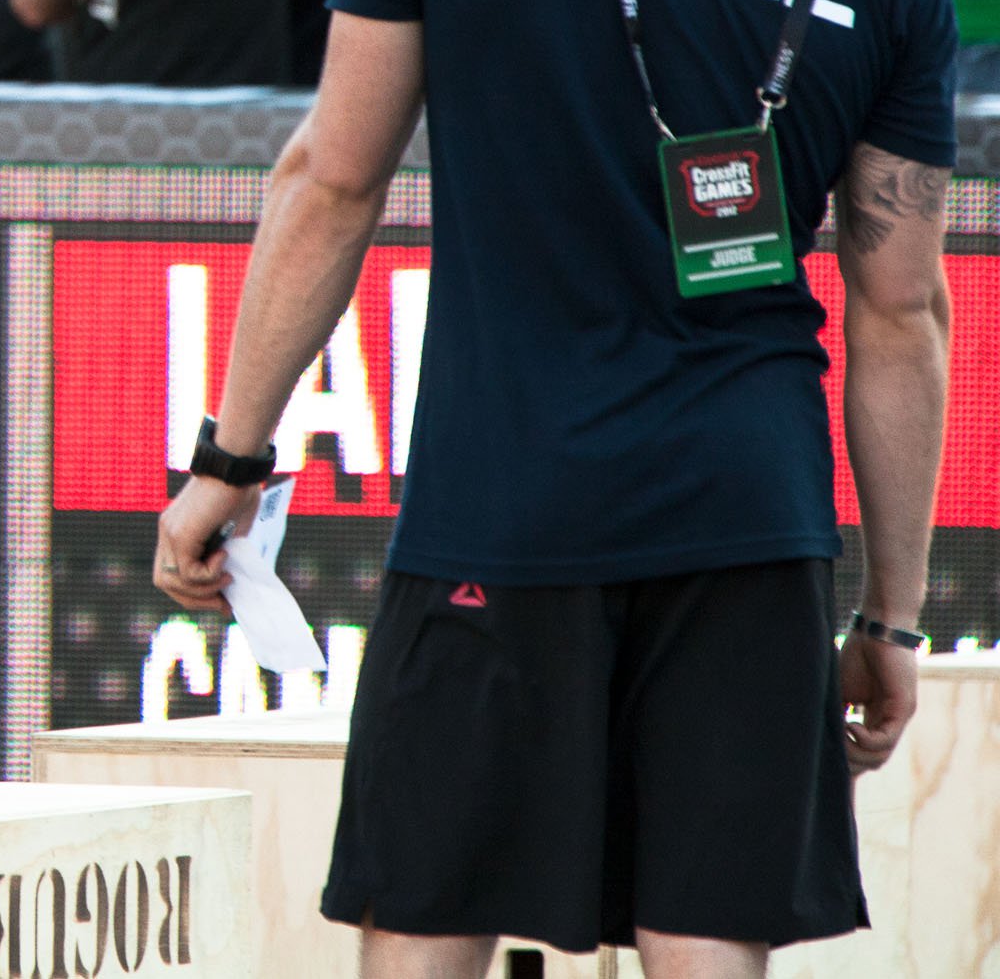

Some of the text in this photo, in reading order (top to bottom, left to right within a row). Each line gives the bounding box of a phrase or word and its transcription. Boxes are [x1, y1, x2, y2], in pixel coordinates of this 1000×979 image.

[691, 160, 750, 186] CrossFit
[693, 181, 753, 203] GAMES
[710, 246, 757, 268] JUDGE
